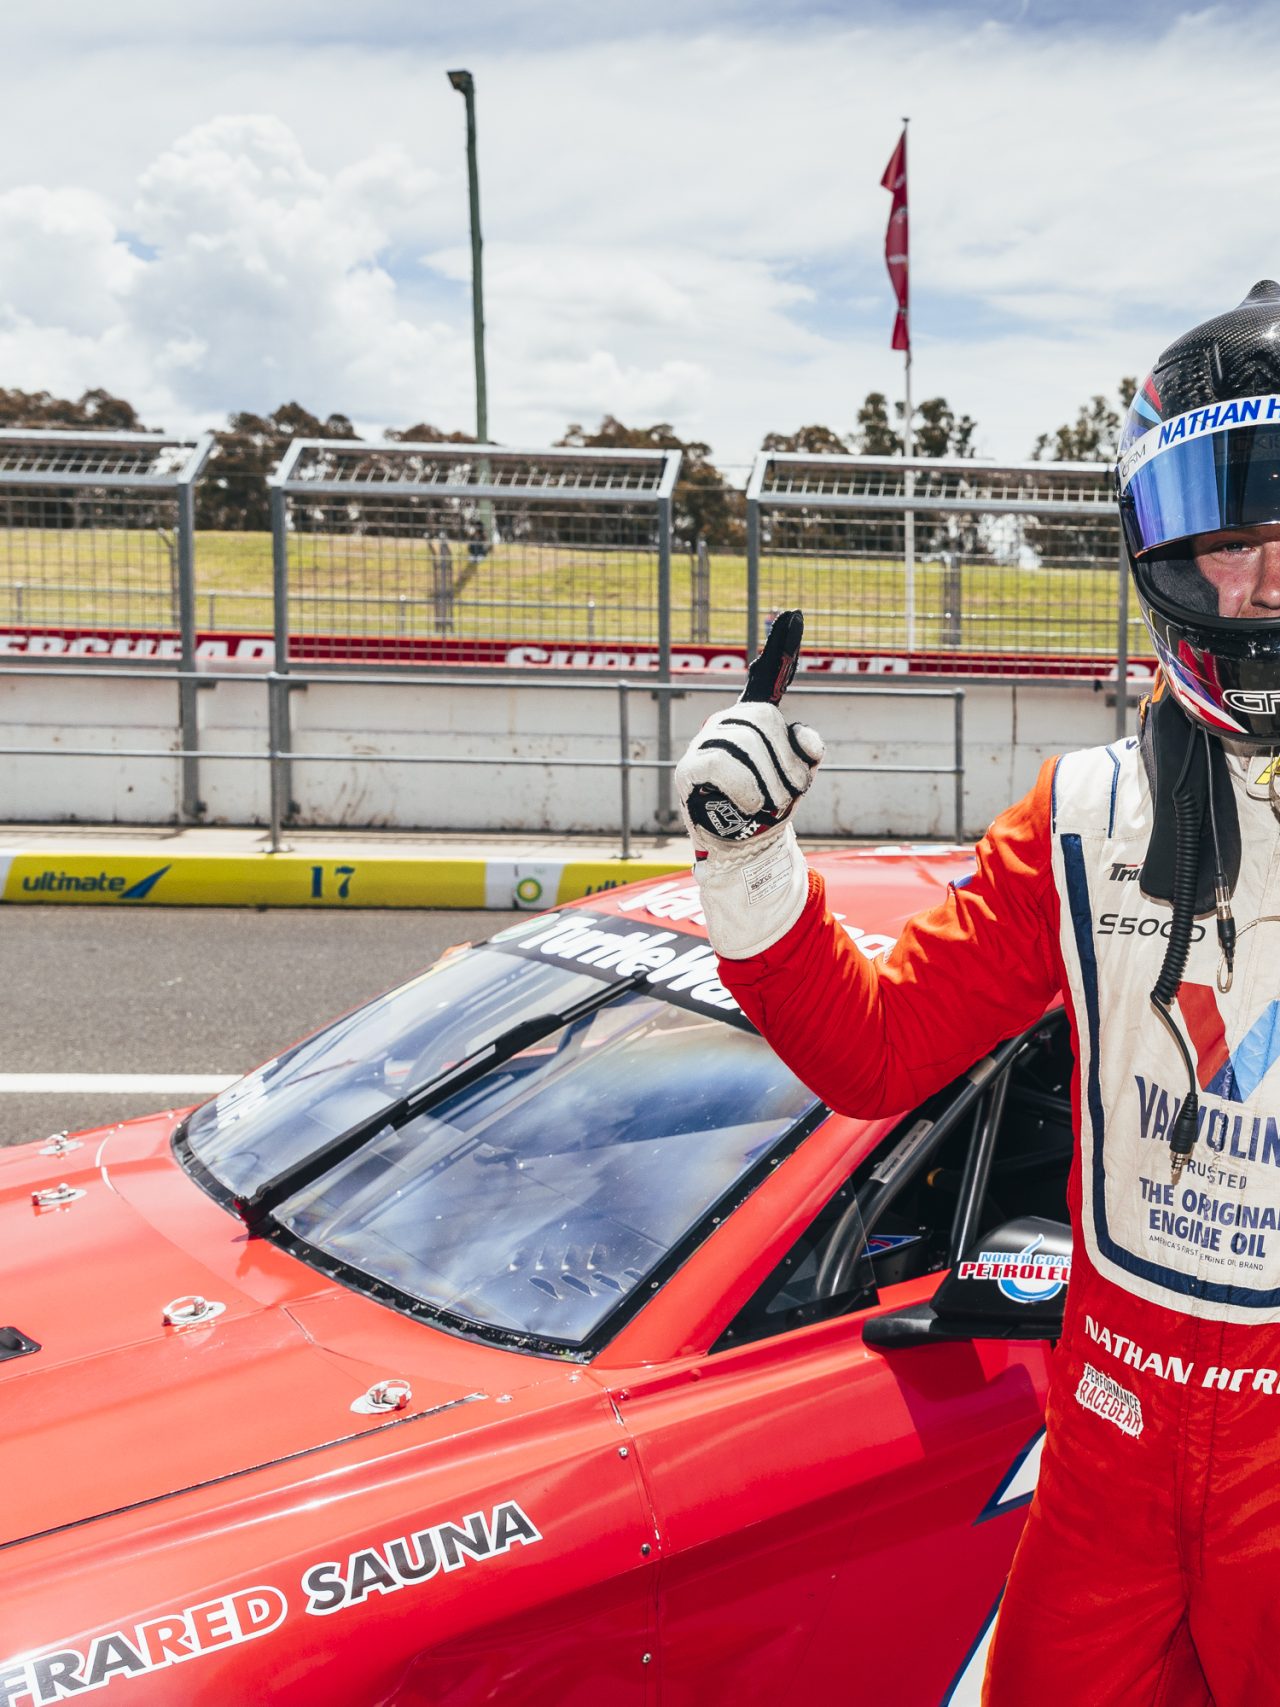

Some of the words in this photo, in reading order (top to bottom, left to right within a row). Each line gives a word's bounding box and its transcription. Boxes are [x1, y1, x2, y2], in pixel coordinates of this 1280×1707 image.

[1158, 400, 1259, 449] NATHAN
[22, 871, 126, 892] ultimate
[310, 865, 356, 899] 17
[1139, 1177, 1175, 1207] THE
[1186, 1158, 1247, 1190] RUSTED
[1149, 1209, 1222, 1252] ENGINE
[1230, 1232, 1266, 1258] OIL
[1149, 1235, 1182, 1251] AMERICA'S
[1181, 1244, 1199, 1257] FIRST
[1239, 1261, 1264, 1271] BRAND
[980, 1252, 1030, 1264] NORTH
[1085, 1315, 1195, 1384] NATHAN
[1080, 1380, 1141, 1432] RACEGEAR
[1086, 1365, 1140, 1412] PERFORMANCE
[301, 1500, 543, 1616] SAUNA
